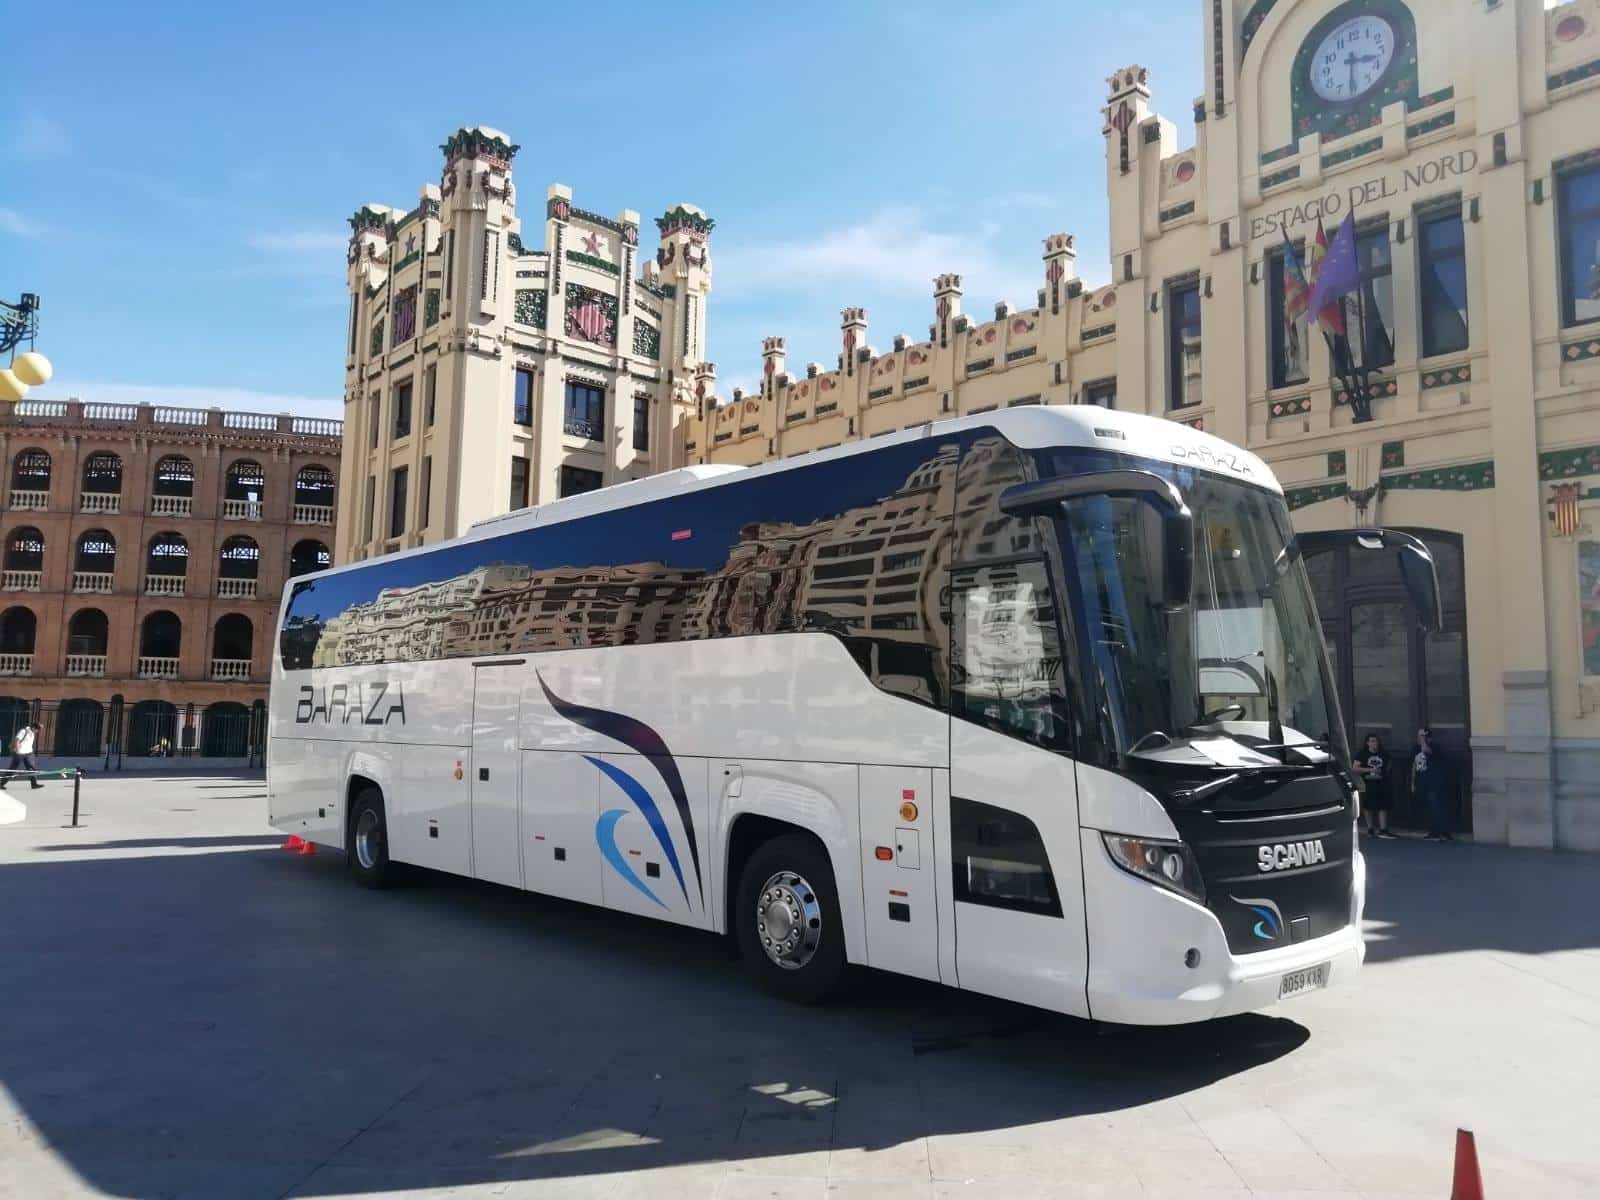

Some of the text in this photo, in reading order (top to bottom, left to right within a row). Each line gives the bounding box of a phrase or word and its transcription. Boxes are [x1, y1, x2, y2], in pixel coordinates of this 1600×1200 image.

[1348, 176, 1398, 208] DEL
[1403, 150, 1478, 192] NORD
[296, 682, 406, 725] BARAZA
[1257, 839, 1326, 872] SCANIA
[1282, 973, 1305, 994] 8059
